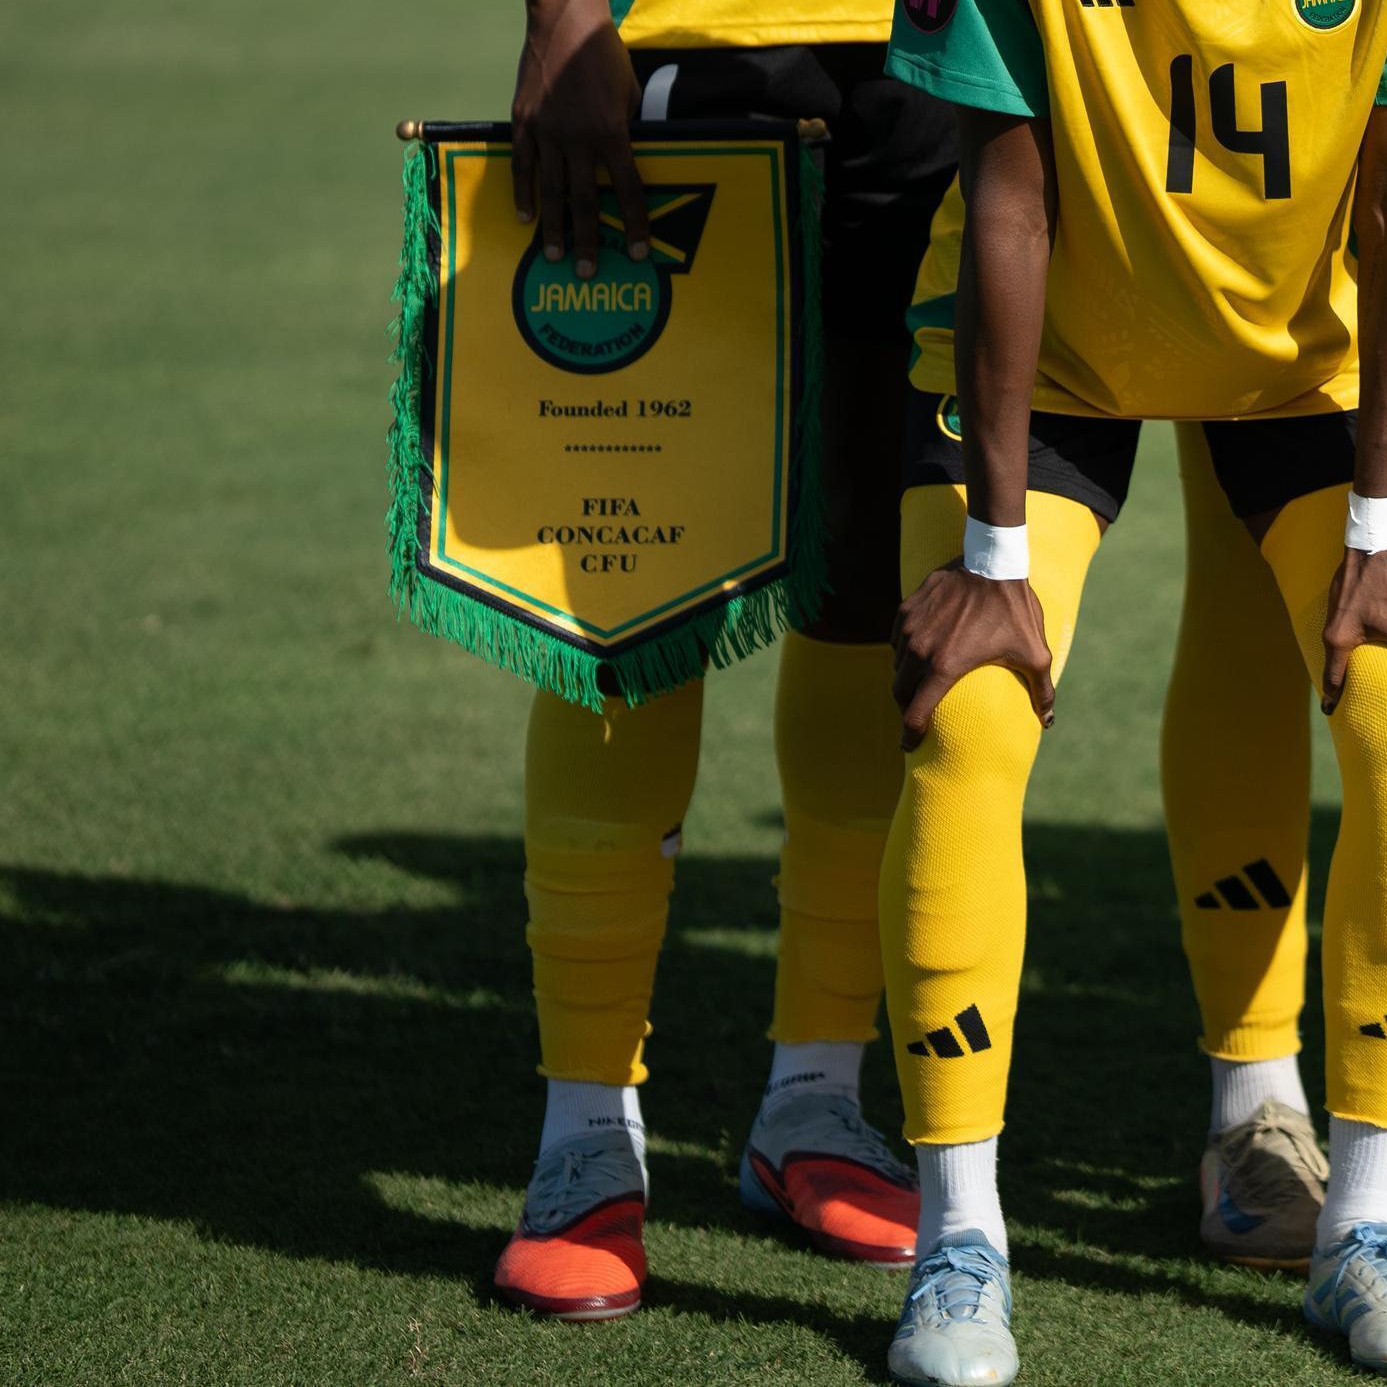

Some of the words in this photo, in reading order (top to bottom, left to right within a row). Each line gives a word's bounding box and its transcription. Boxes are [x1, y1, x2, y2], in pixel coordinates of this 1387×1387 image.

[1165, 53, 1291, 200] 14
[530, 281, 652, 313] JAMAICA
[537, 321, 647, 357] FEDERATION
[538, 398, 629, 419] Founded
[637, 399, 692, 418] 1962
[580, 497, 641, 518] FIFA
[537, 524, 686, 546] CONCACAF
[580, 553, 639, 574] CFU
